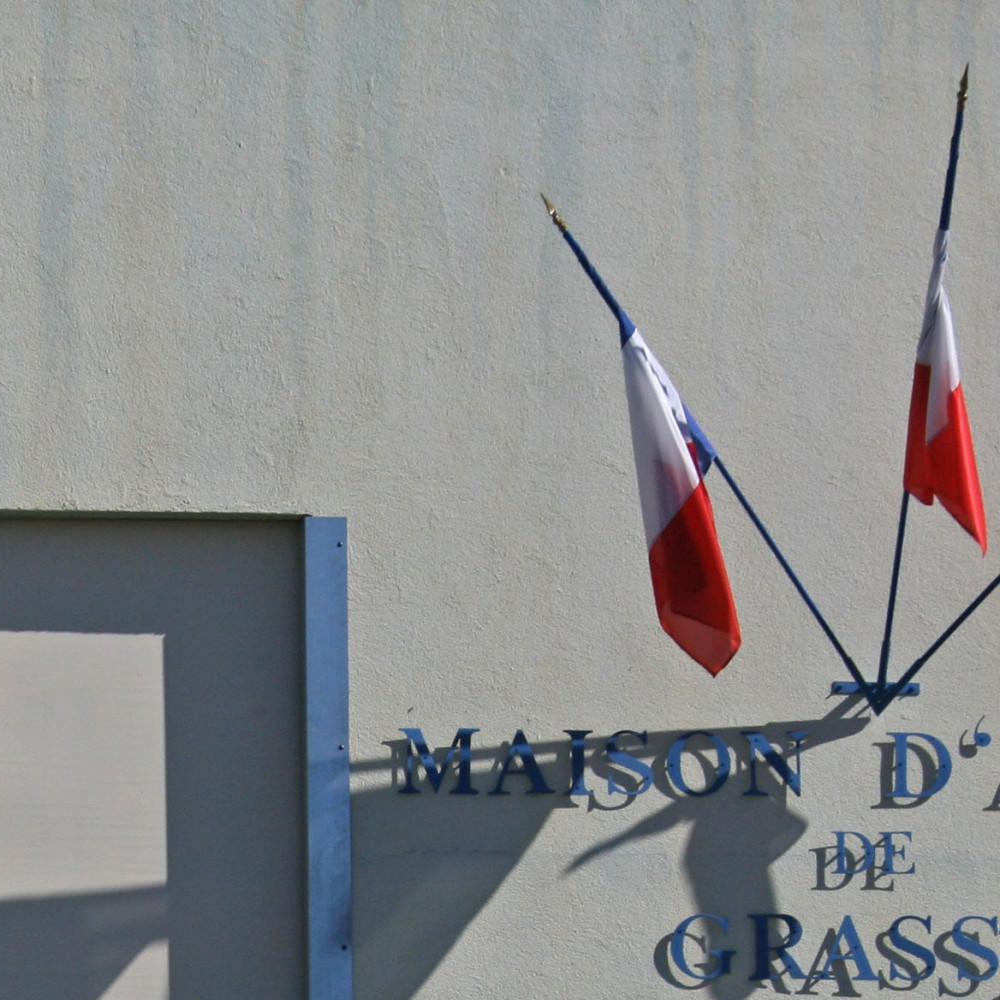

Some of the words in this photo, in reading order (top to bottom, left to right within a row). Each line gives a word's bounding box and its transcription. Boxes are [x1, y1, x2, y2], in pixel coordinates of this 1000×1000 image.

[398, 727, 809, 798] MAISON
[831, 830, 916, 875] DE
[670, 912, 999, 982] GRASS
